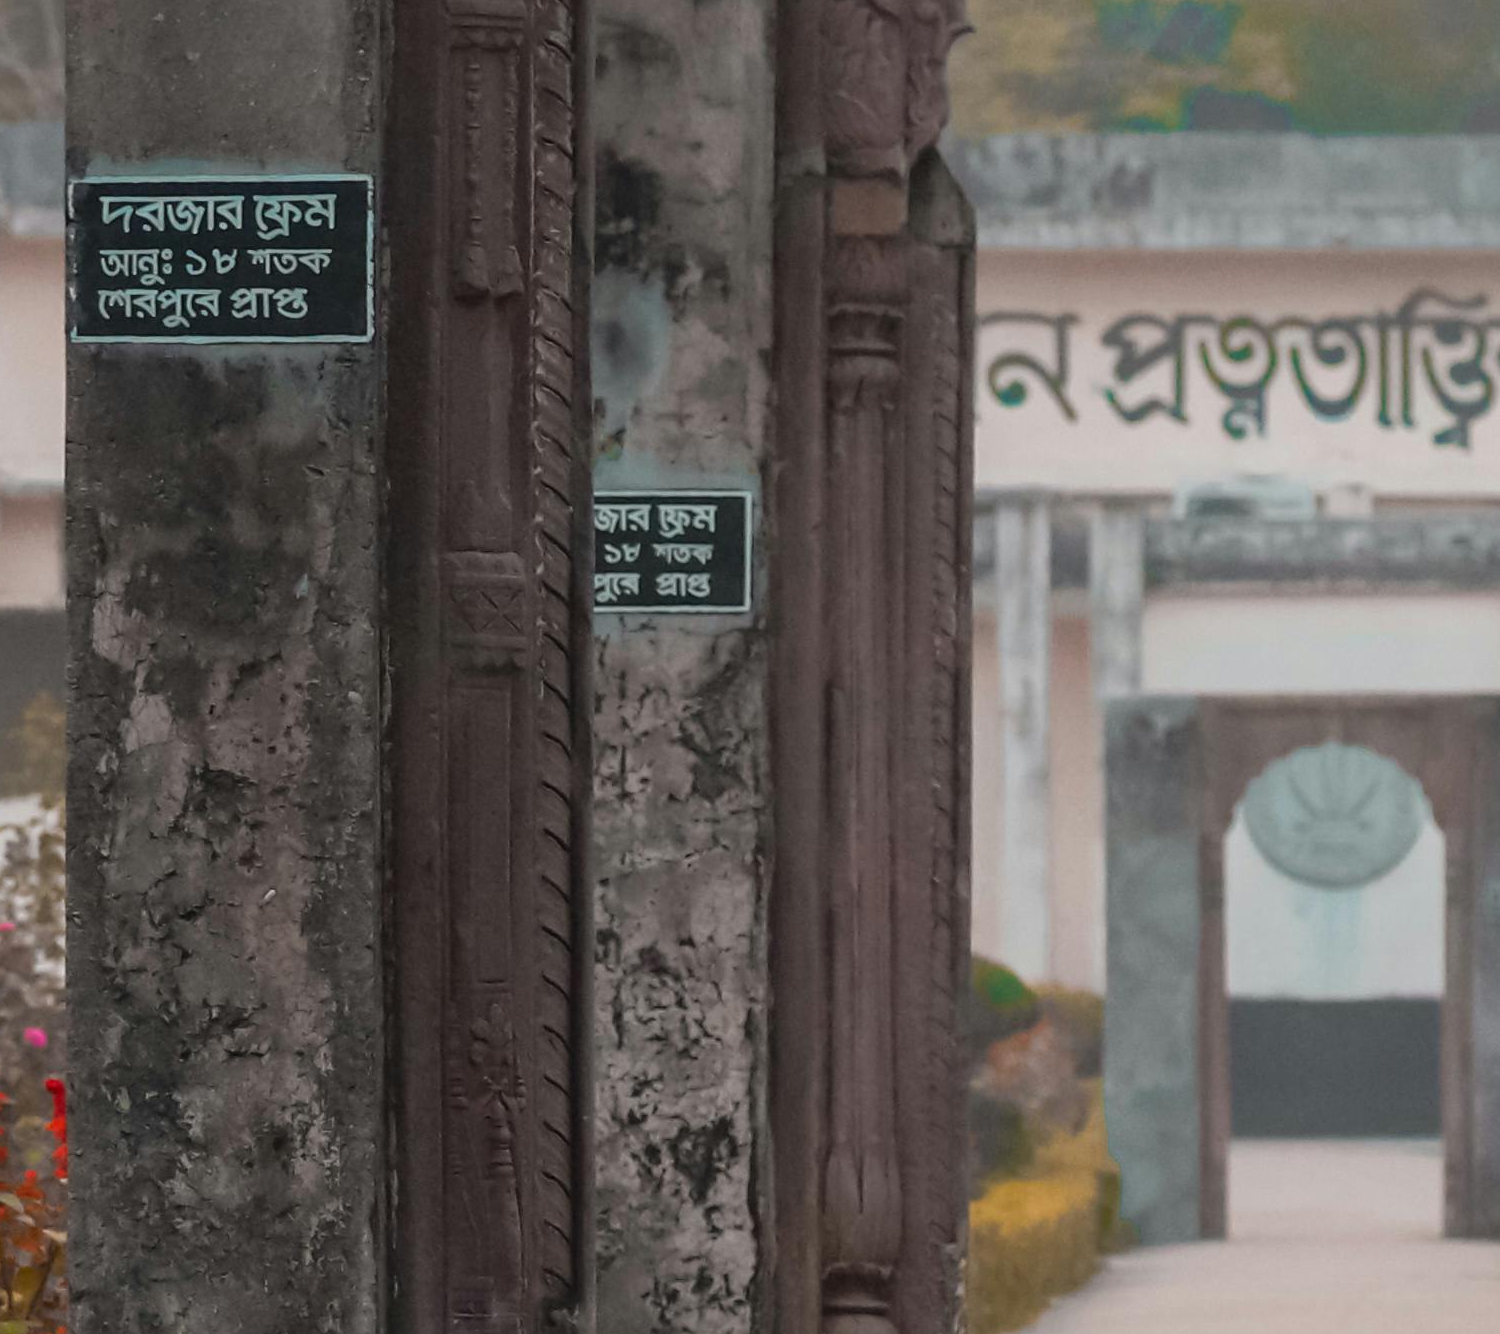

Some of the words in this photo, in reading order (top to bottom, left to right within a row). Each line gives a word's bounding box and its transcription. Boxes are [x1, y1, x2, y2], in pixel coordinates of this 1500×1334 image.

[99, 195, 245, 235] দরজার
[253, 194, 337, 241] ফ্রেম
[185, 248, 238, 276] ১৮
[247, 248, 333, 275] শতক
[98, 288, 222, 328] শেরপুরে
[230, 287, 309, 319] প্রাপ্ত
[594, 504, 651, 534] জার
[657, 504, 718, 538] ফ্রেম
[604, 543, 641, 564] ১৮
[652, 543, 714, 565] শতক
[594, 572, 641, 602] পুরে
[655, 572, 711, 598] প্রাপ্ত
